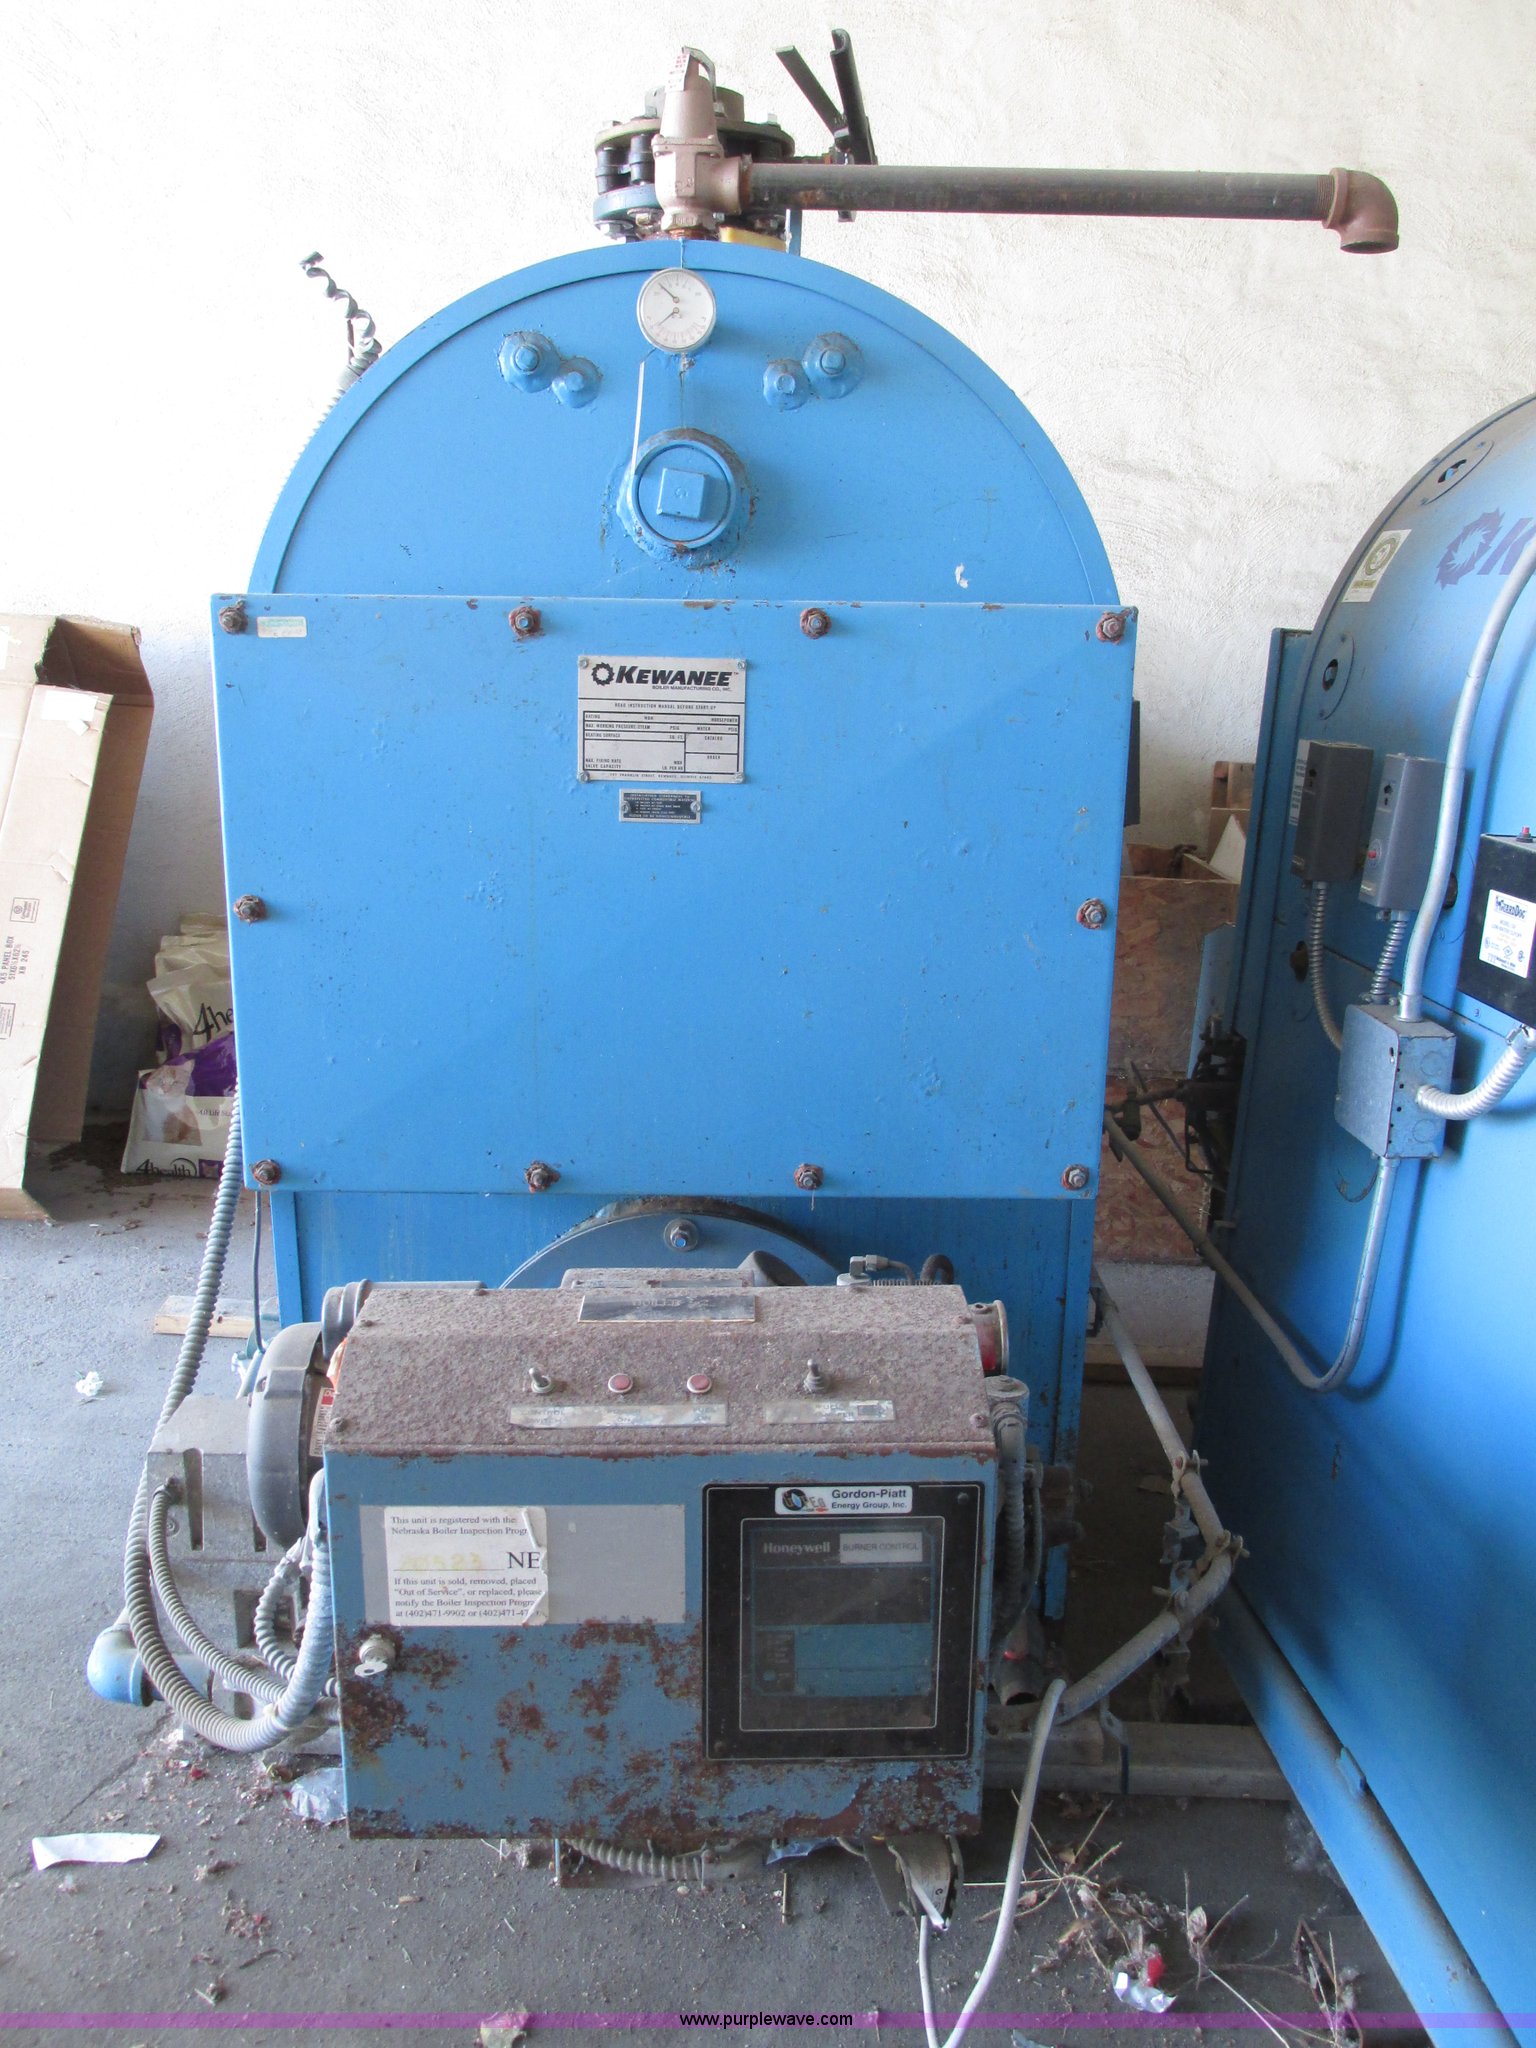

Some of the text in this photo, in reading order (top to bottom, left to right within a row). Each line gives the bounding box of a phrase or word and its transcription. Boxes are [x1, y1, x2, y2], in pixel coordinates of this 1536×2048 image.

[615, 664, 733, 686] KEWANEE
[5, 936, 14, 948] BOX
[2, 951, 12, 970] PANEL
[831, 1489, 907, 1498] Gordon-Piatt
[831, 1502, 861, 1510] Energy
[862, 1501, 890, 1509] Group,
[392, 1516, 409, 1524] This
[439, 1516, 480, 1525] registered
[482, 1516, 500, 1524] with
[502, 1516, 516, 1524] the
[391, 1527, 429, 1535] Nebraska
[460, 1527, 502, 1536] Inspection
[762, 1542, 831, 1556] Honeywell
[842, 1542, 919, 1552] BURNER CONTROL
[506, 1552, 541, 1569] NE
[448, 1577, 467, 1586] sold,
[469, 1577, 508, 1585] removed,
[510, 1577, 536, 1586] placed
[416, 1588, 426, 1596] of
[478, 1588, 516, 1596] replaced,
[517, 1588, 542, 1596] please
[395, 1599, 419, 1608] notify
[464, 1599, 506, 1607] Inspection
[405, 1610, 465, 1618] (402)471-9902
